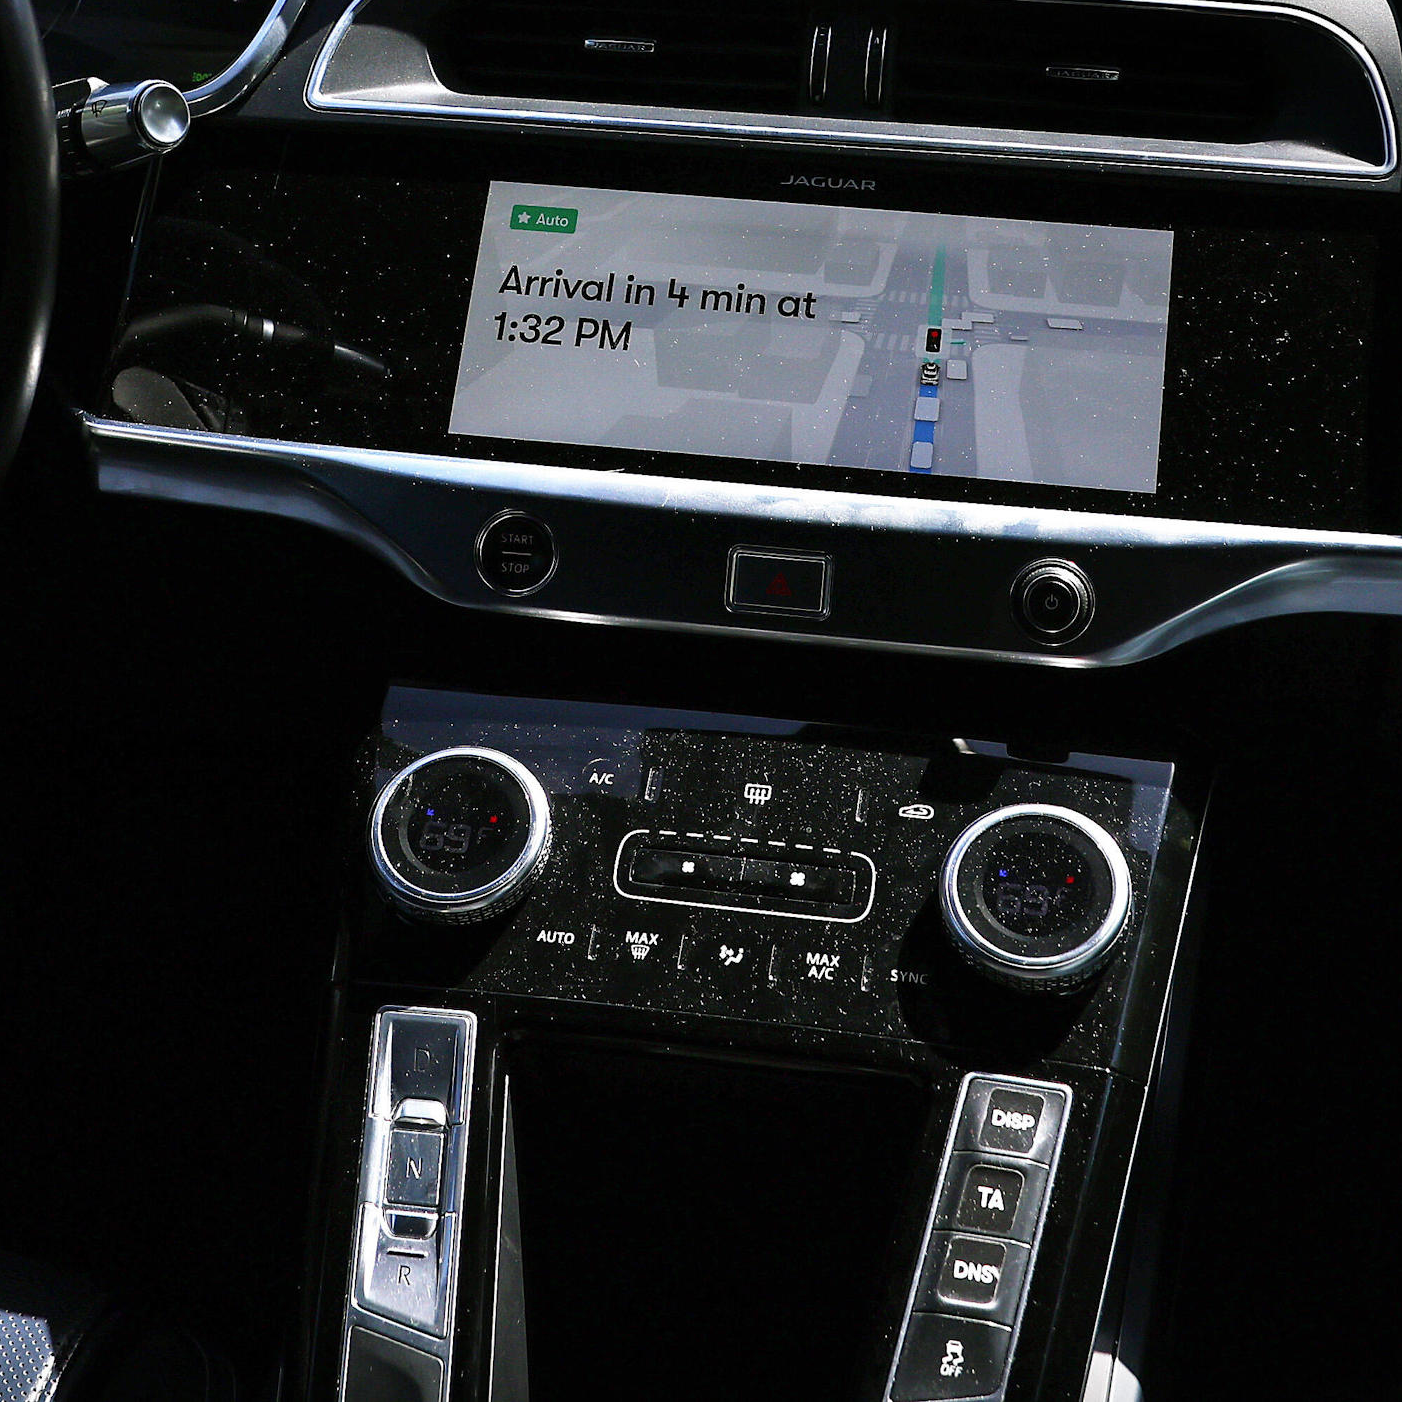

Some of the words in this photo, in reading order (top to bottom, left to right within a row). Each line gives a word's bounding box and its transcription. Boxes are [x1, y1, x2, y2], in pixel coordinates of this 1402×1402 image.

[780, 175, 876, 191] JAGUAR
[535, 213, 569, 228] Auto
[498, 264, 615, 305] Arrival
[624, 274, 655, 306] in
[667, 278, 690, 308] 4
[700, 283, 766, 315] min
[777, 291, 817, 319] at
[494, 312, 564, 346] 1:32
[574, 317, 632, 351] PM
[501, 533, 534, 546] START
[501, 561, 530, 574] STOP
[588, 772, 615, 786] A/C
[536, 930, 576, 945] AUTO
[625, 931, 660, 945] MAX
[805, 952, 841, 969] MAX
[807, 966, 835, 982] A/C
[889, 969, 930, 986] SYNC
[414, 1047, 431, 1073] D
[991, 1109, 1035, 1131] DISP
[406, 1156, 423, 1180] N
[977, 1185, 1005, 1212] TA
[398, 1265, 411, 1286] R
[940, 1363, 963, 1379] OFF
